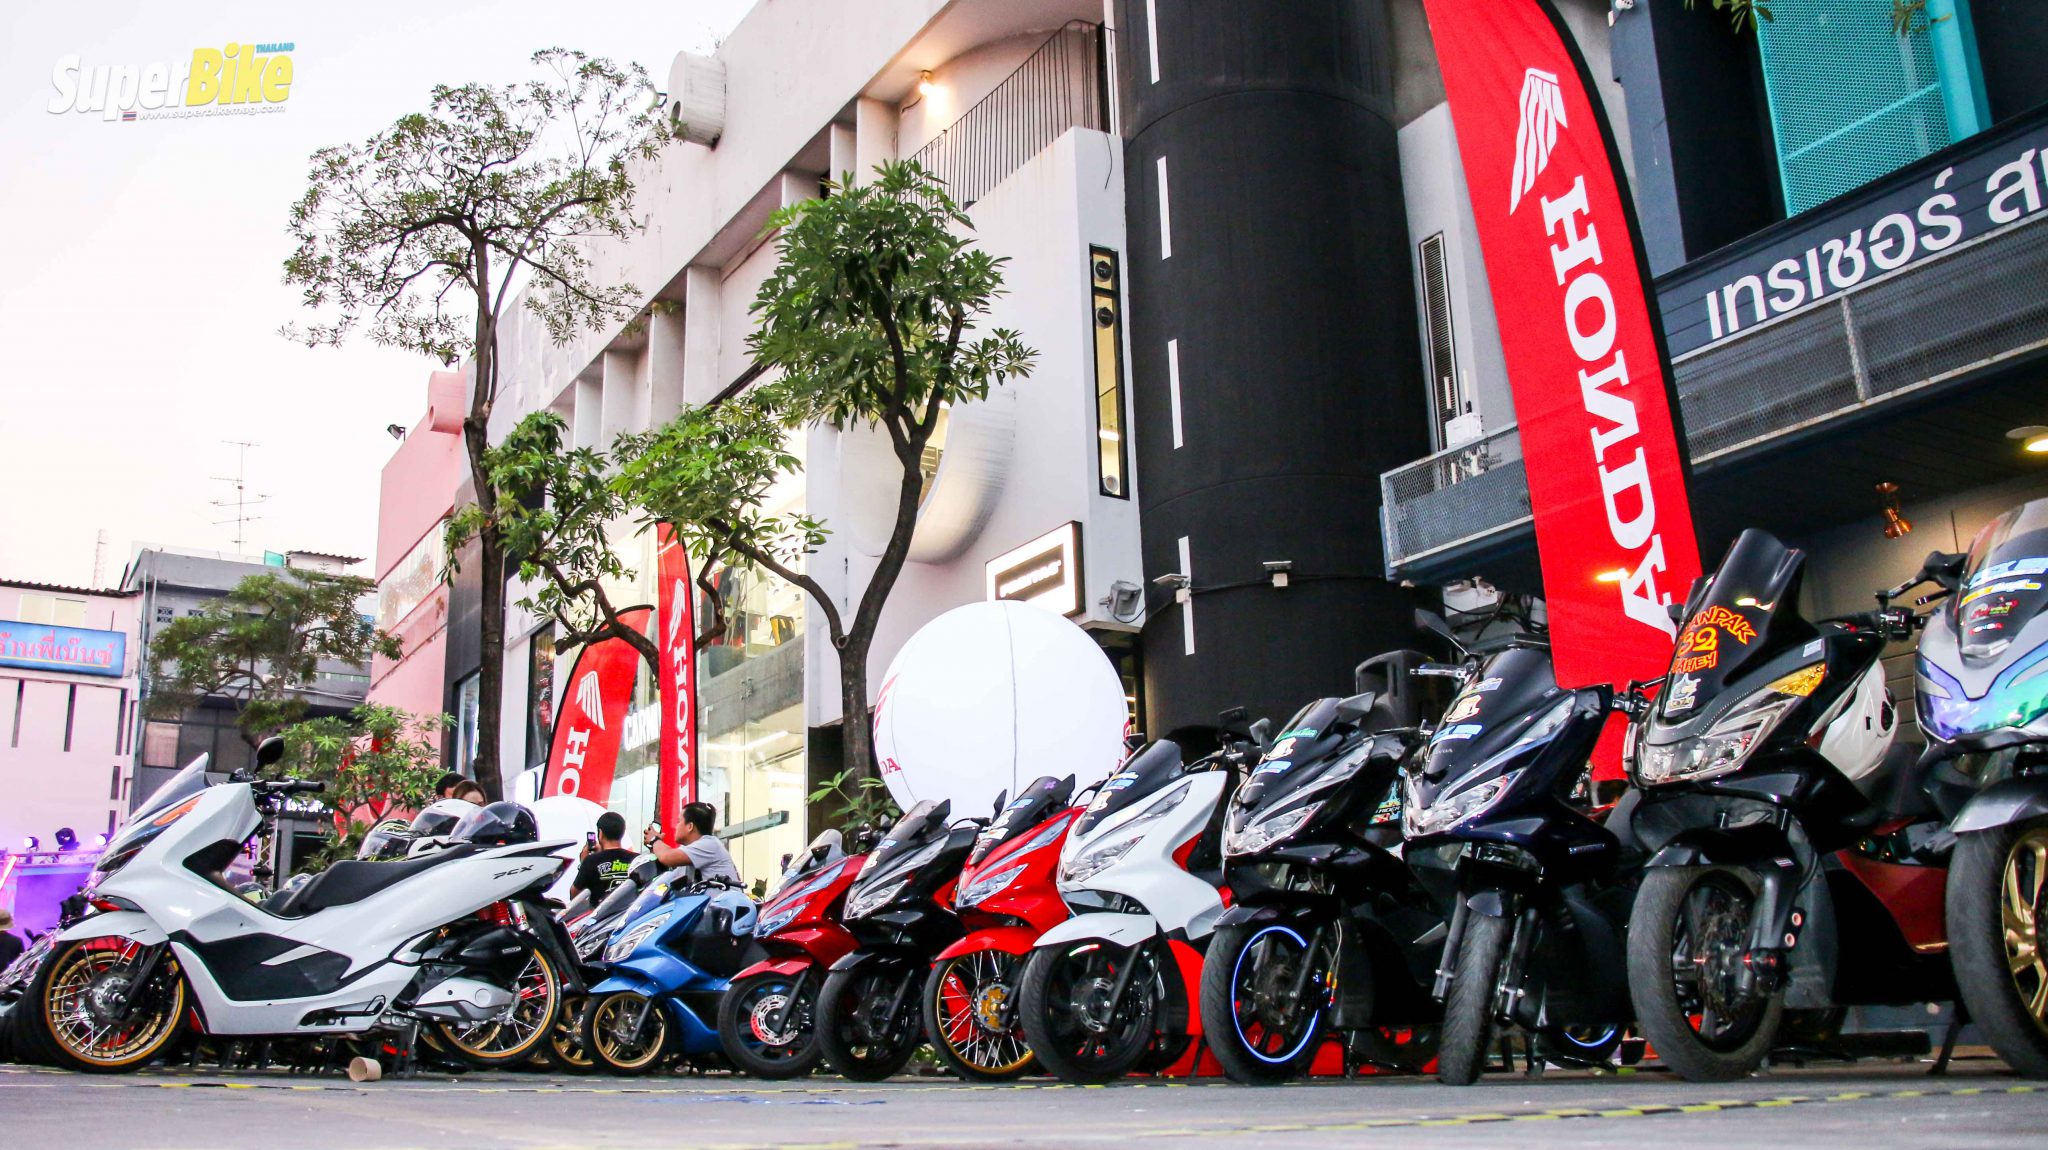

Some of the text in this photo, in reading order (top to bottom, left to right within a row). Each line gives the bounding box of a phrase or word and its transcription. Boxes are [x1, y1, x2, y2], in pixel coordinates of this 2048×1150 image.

[1707, 167, 1963, 340] เทรเชอร์
[1682, 605, 1757, 646] ANPAK
[493, 864, 534, 880] PCX
